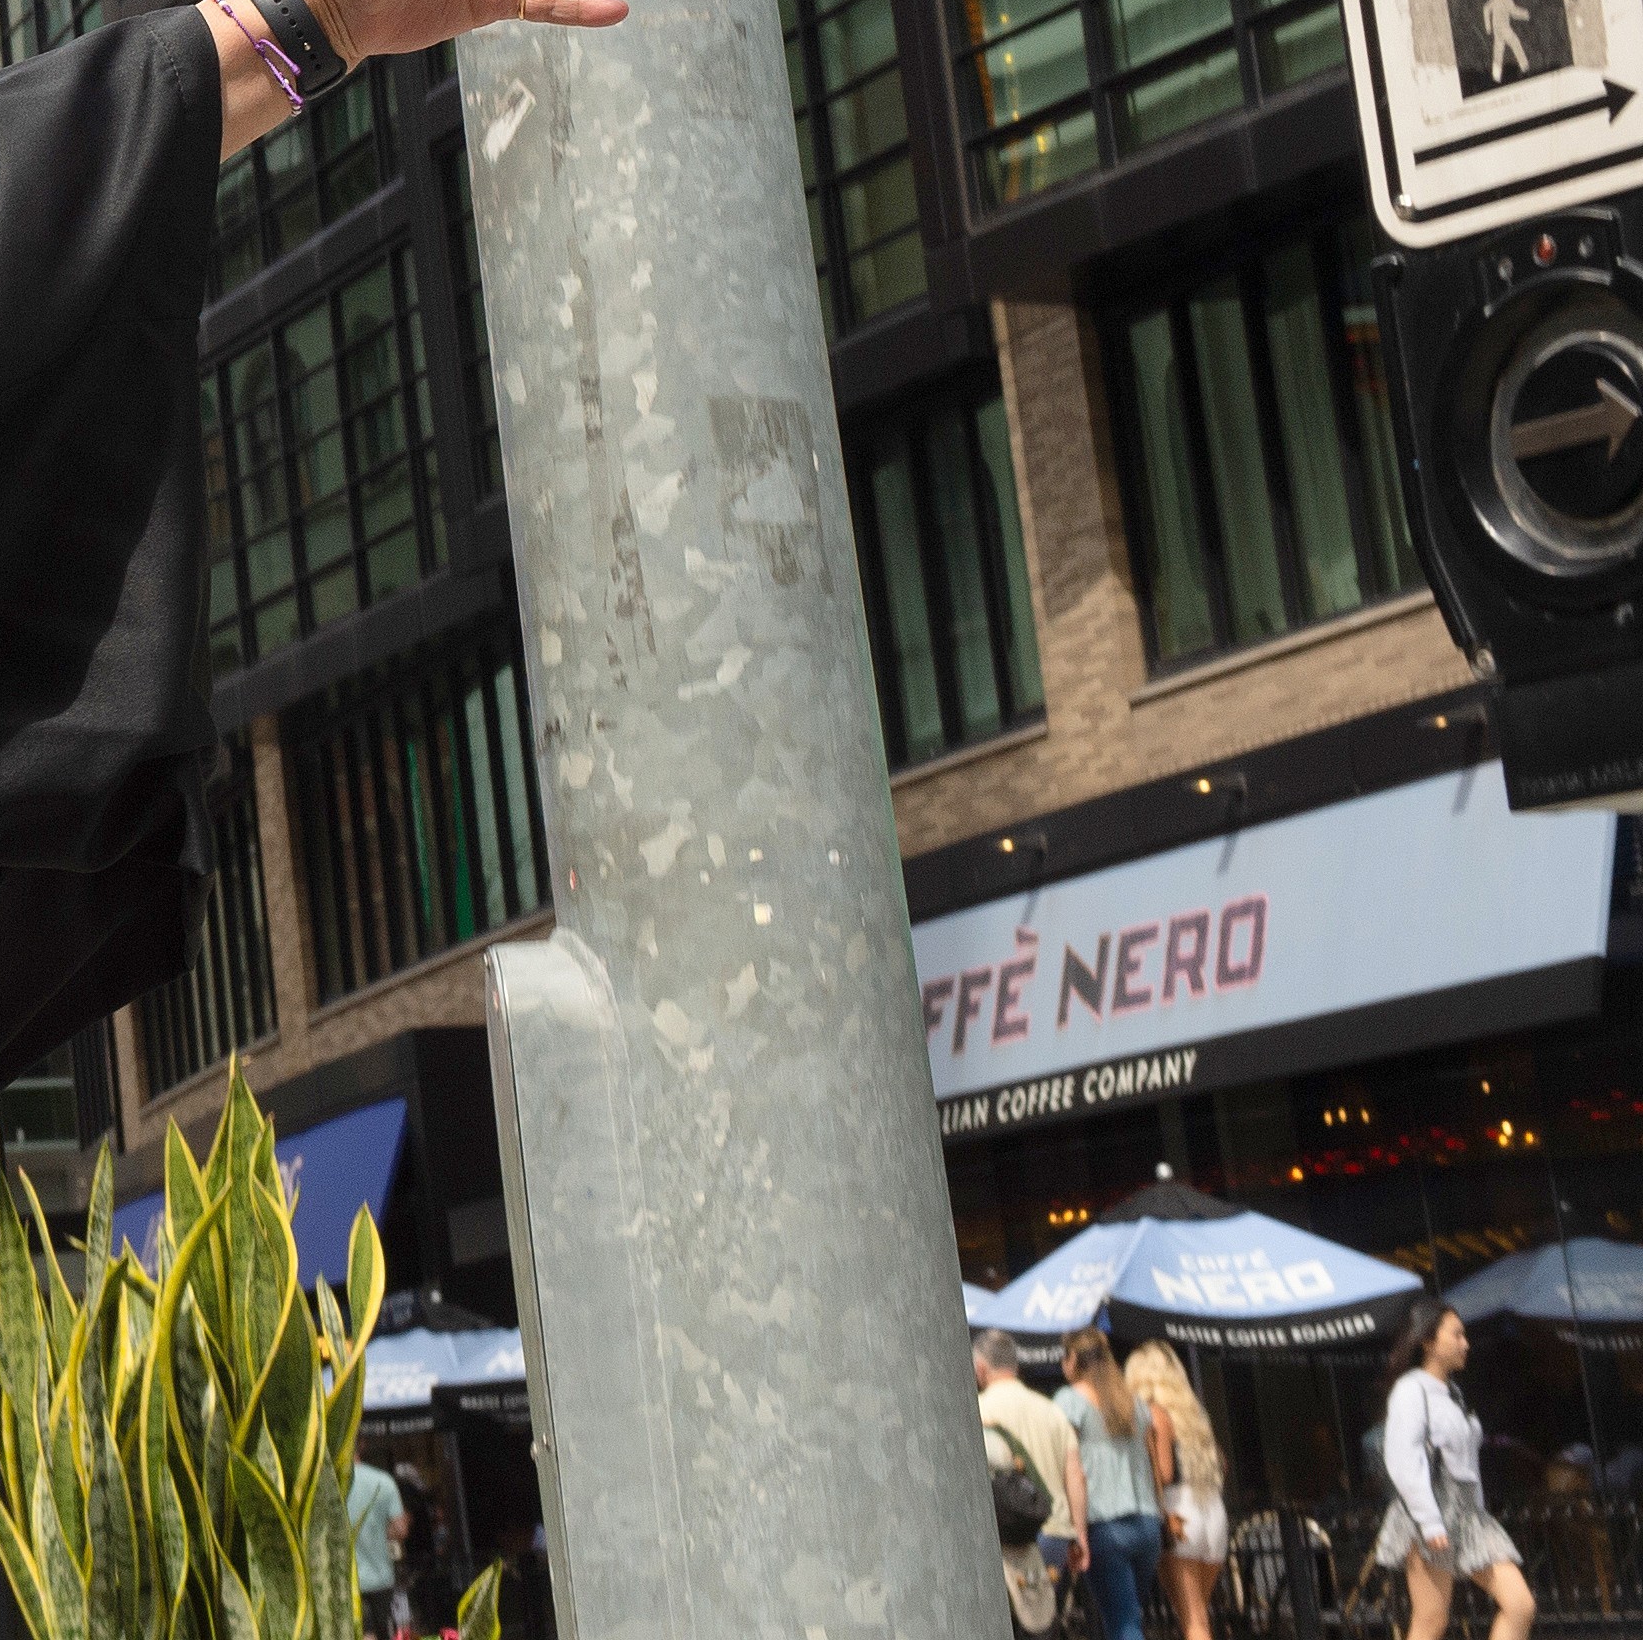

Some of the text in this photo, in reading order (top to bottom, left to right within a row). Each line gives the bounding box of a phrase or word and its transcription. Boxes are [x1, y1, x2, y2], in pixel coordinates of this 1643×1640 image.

[921, 891, 1270, 1055] FFÈ NERO
[942, 1048, 1197, 1136] LIAN COFFEE COMPANY
[1151, 1260, 1335, 1306] NERO
[1224, 1326, 1289, 1348] COFFEE
[1290, 1312, 1376, 1344] ROASTERS
